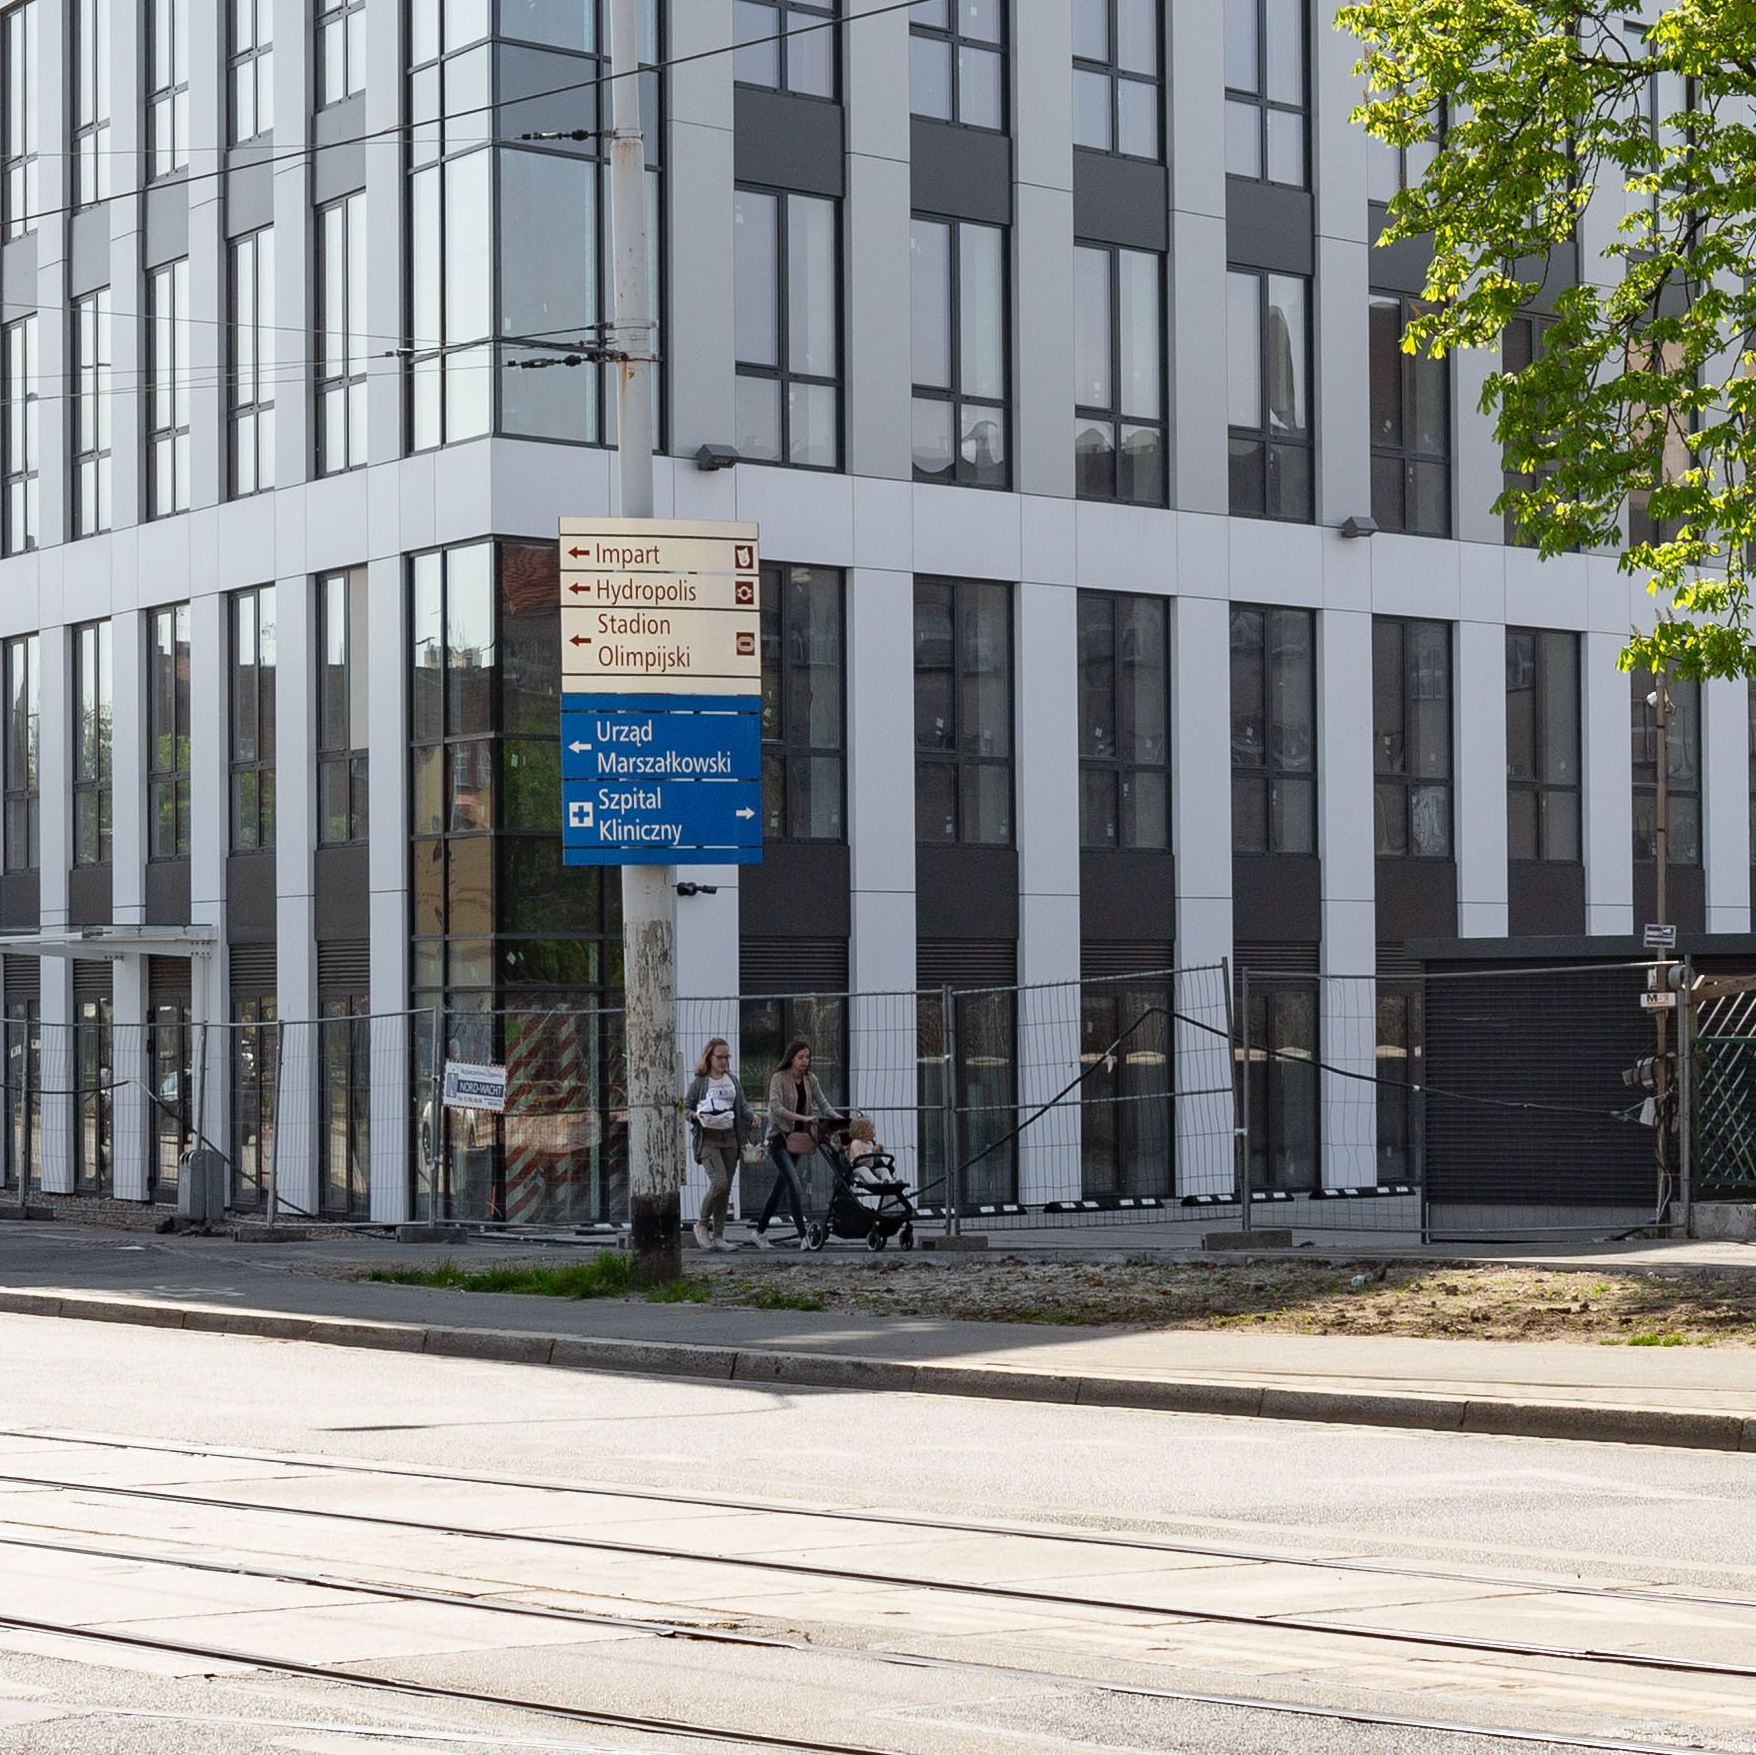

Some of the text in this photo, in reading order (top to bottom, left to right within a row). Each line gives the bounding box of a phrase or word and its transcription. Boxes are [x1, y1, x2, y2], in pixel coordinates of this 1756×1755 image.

[596, 543, 660, 569] Impart
[596, 578, 697, 605] Hydropolis
[598, 612, 671, 635] Stadion
[598, 645, 691, 673] Olimpijski
[597, 719, 653, 747] Urząd
[597, 750, 732, 774] Marszałkowski
[598, 787, 662, 815] Szpital
[599, 819, 683, 846] Kliniczny
[459, 1081, 503, 1096] NORD-WACHT
